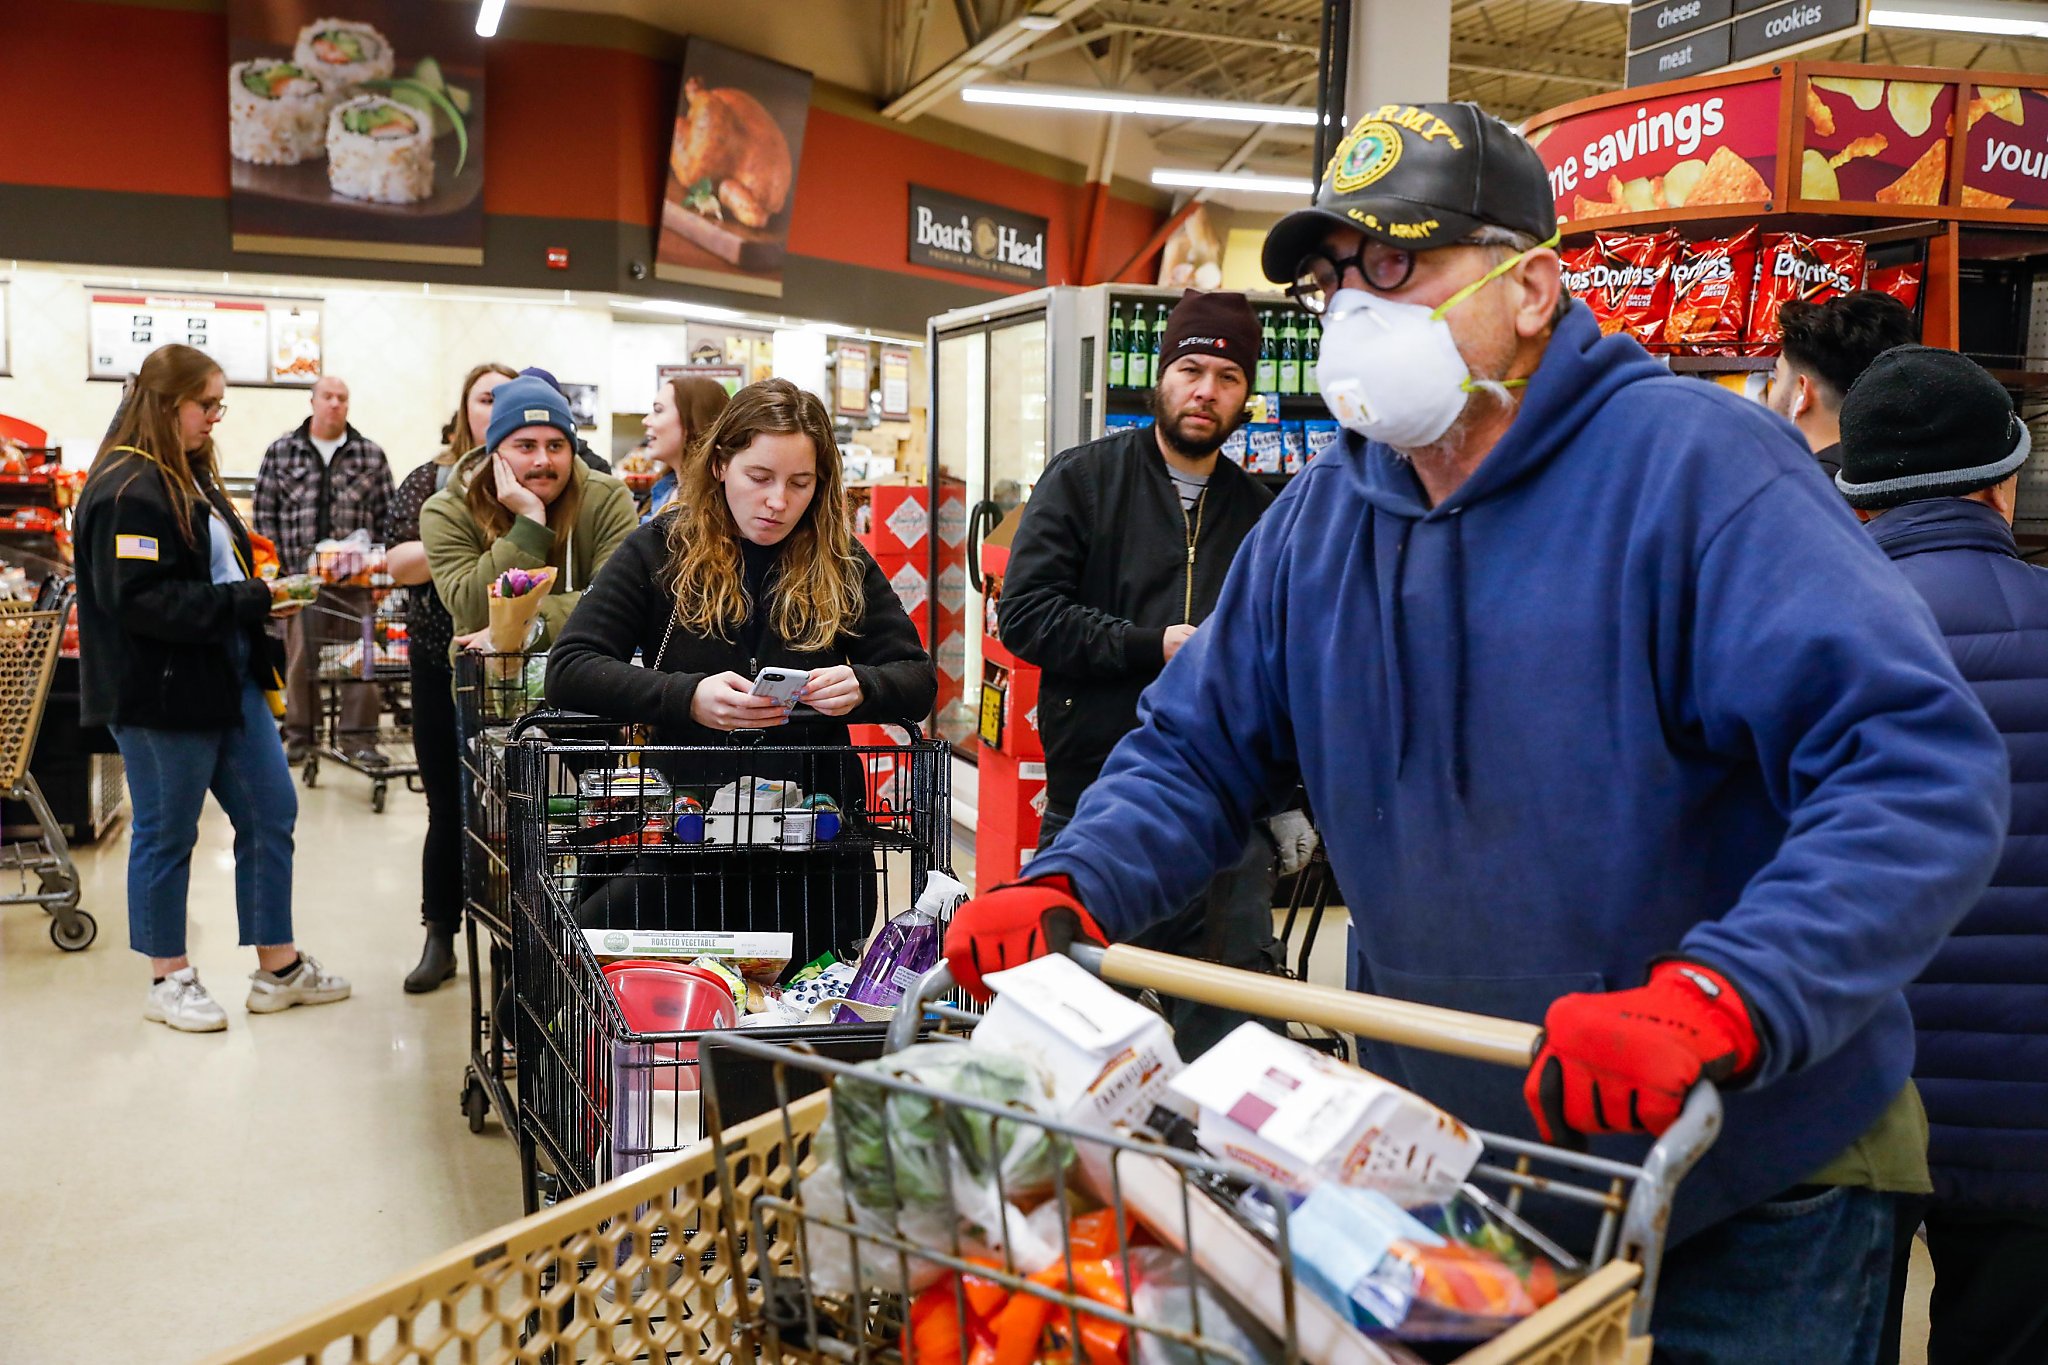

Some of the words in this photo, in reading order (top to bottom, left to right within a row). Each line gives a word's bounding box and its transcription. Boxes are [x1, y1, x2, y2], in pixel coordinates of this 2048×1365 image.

[1657, 1, 1701, 29] cheese
[1765, 5, 1822, 38] cookies
[1658, 45, 1693, 73] meat
[1583, 97, 1725, 179] savings
[1347, 208, 1383, 231] U.S.
[917, 205, 973, 254] Boar's
[997, 225, 1043, 270] Head
[1594, 265, 1655, 288] Doritos
[1774, 253, 1851, 291] Doritos
[1178, 336, 1216, 348] SAFEWAY
[651, 938, 680, 946] ROASTED
[681, 939, 716, 947] VEGETABLE
